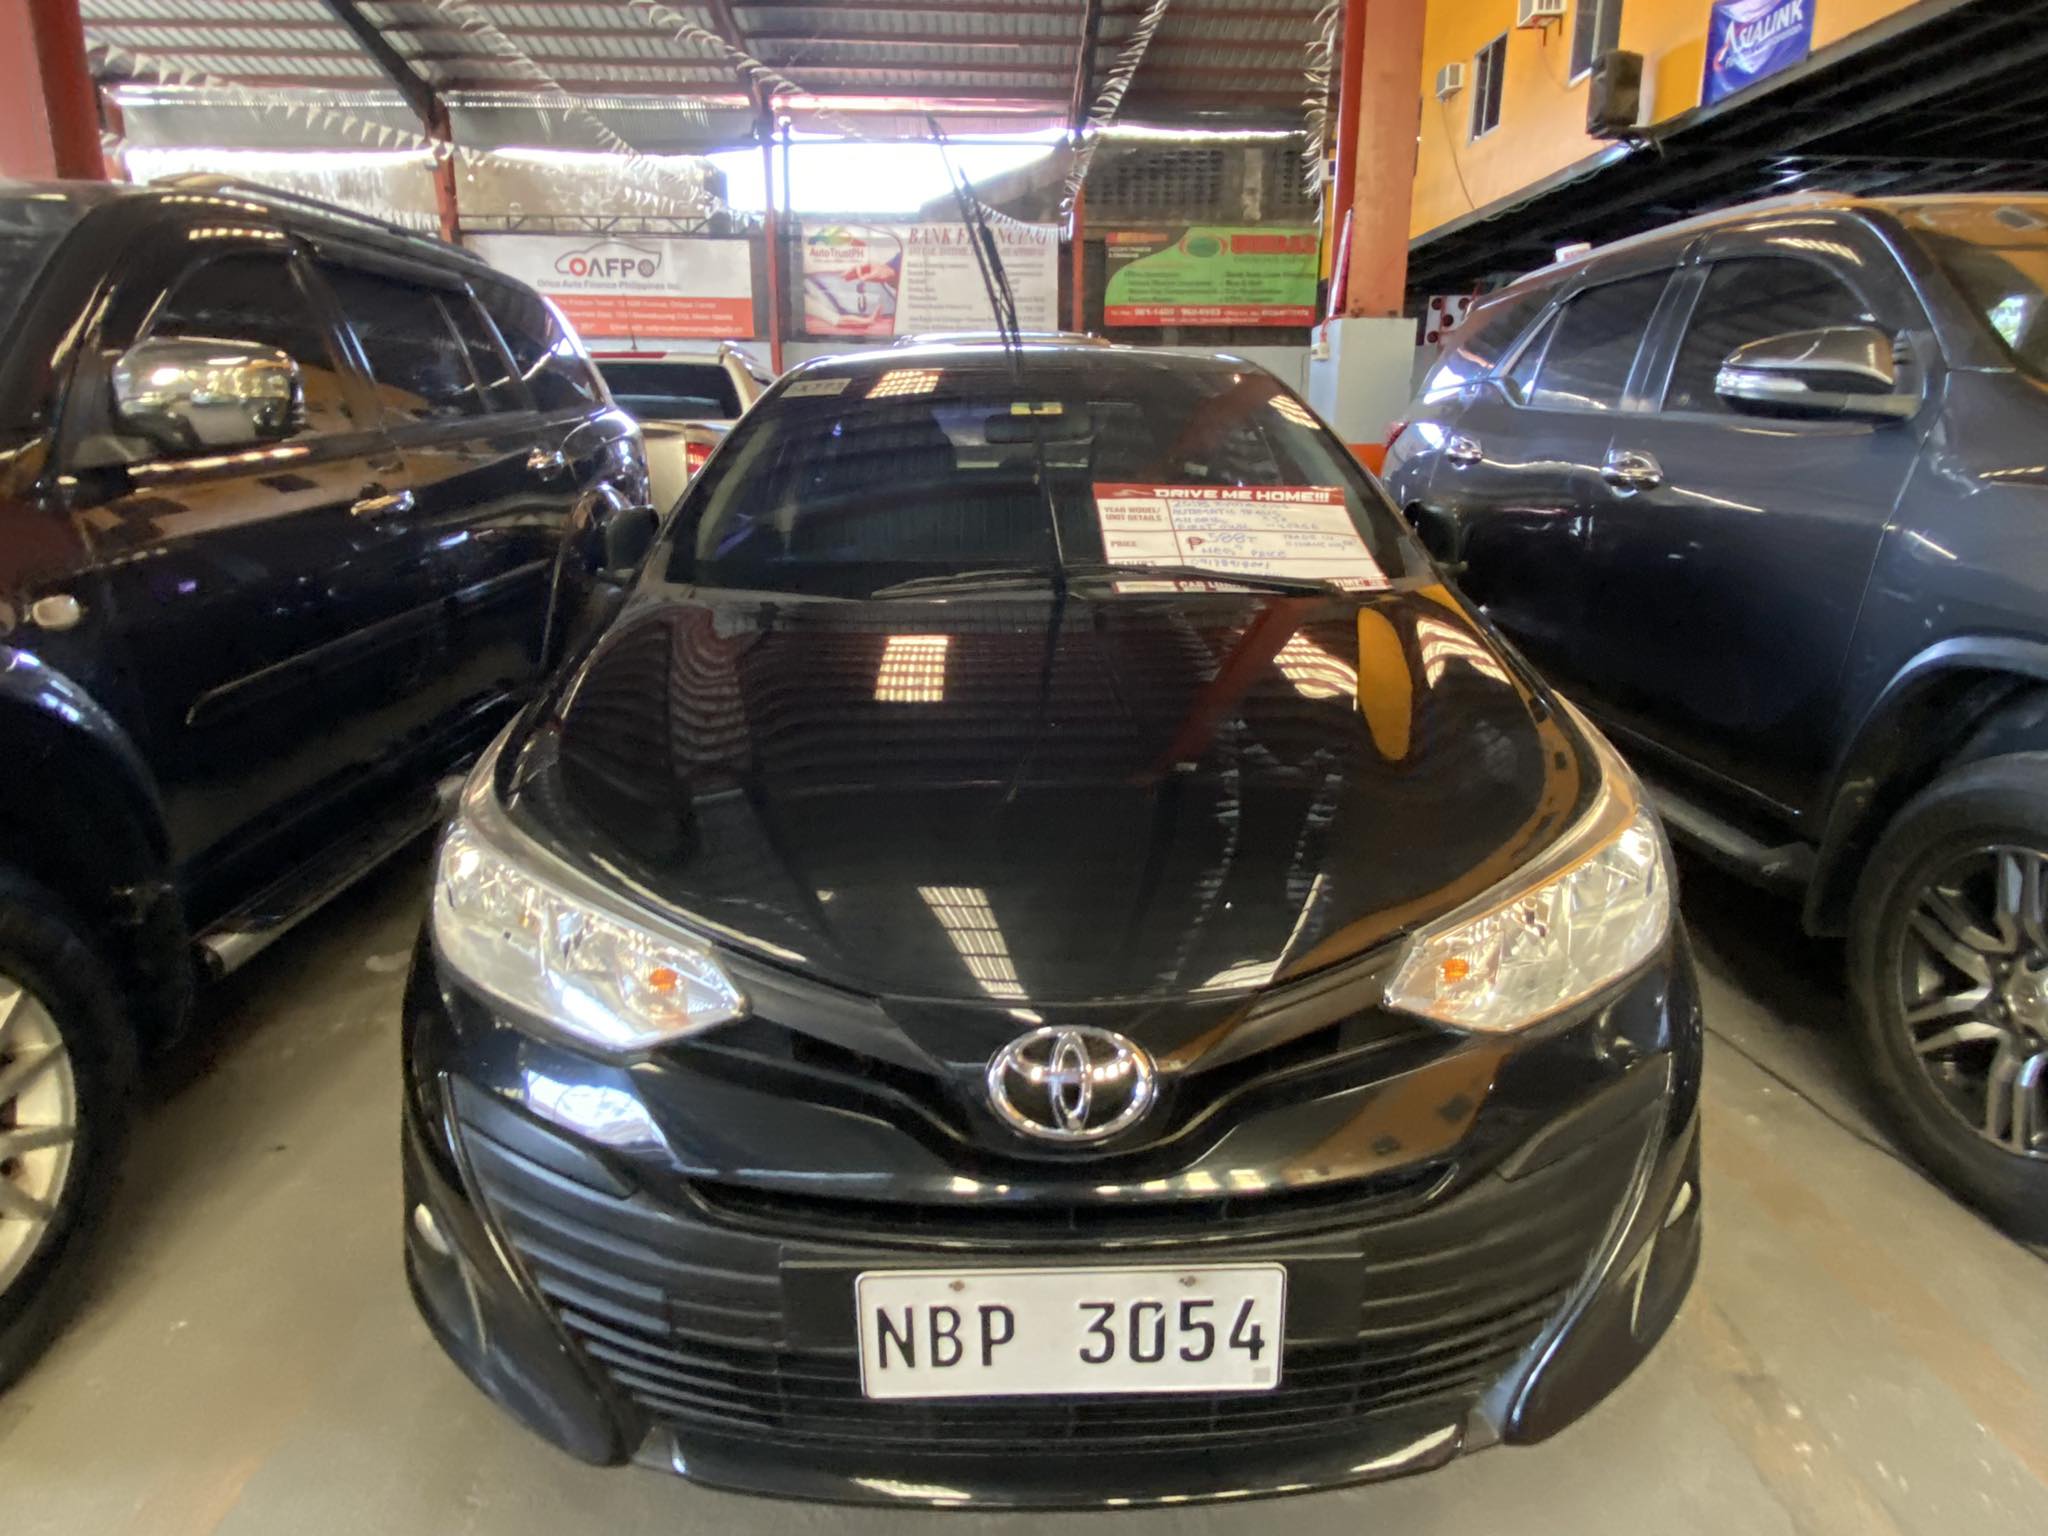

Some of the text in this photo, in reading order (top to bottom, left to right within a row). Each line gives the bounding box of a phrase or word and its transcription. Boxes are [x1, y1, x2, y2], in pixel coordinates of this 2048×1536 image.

[1723, 0, 1804, 54] ASIALINK
[908, 228, 952, 247] BANK
[809, 247, 865, 258] AutoTrustPH
[1153, 488, 1330, 502] DRIVE ME HOME!!!
[875, 1297, 1267, 1370] NBP 3054
